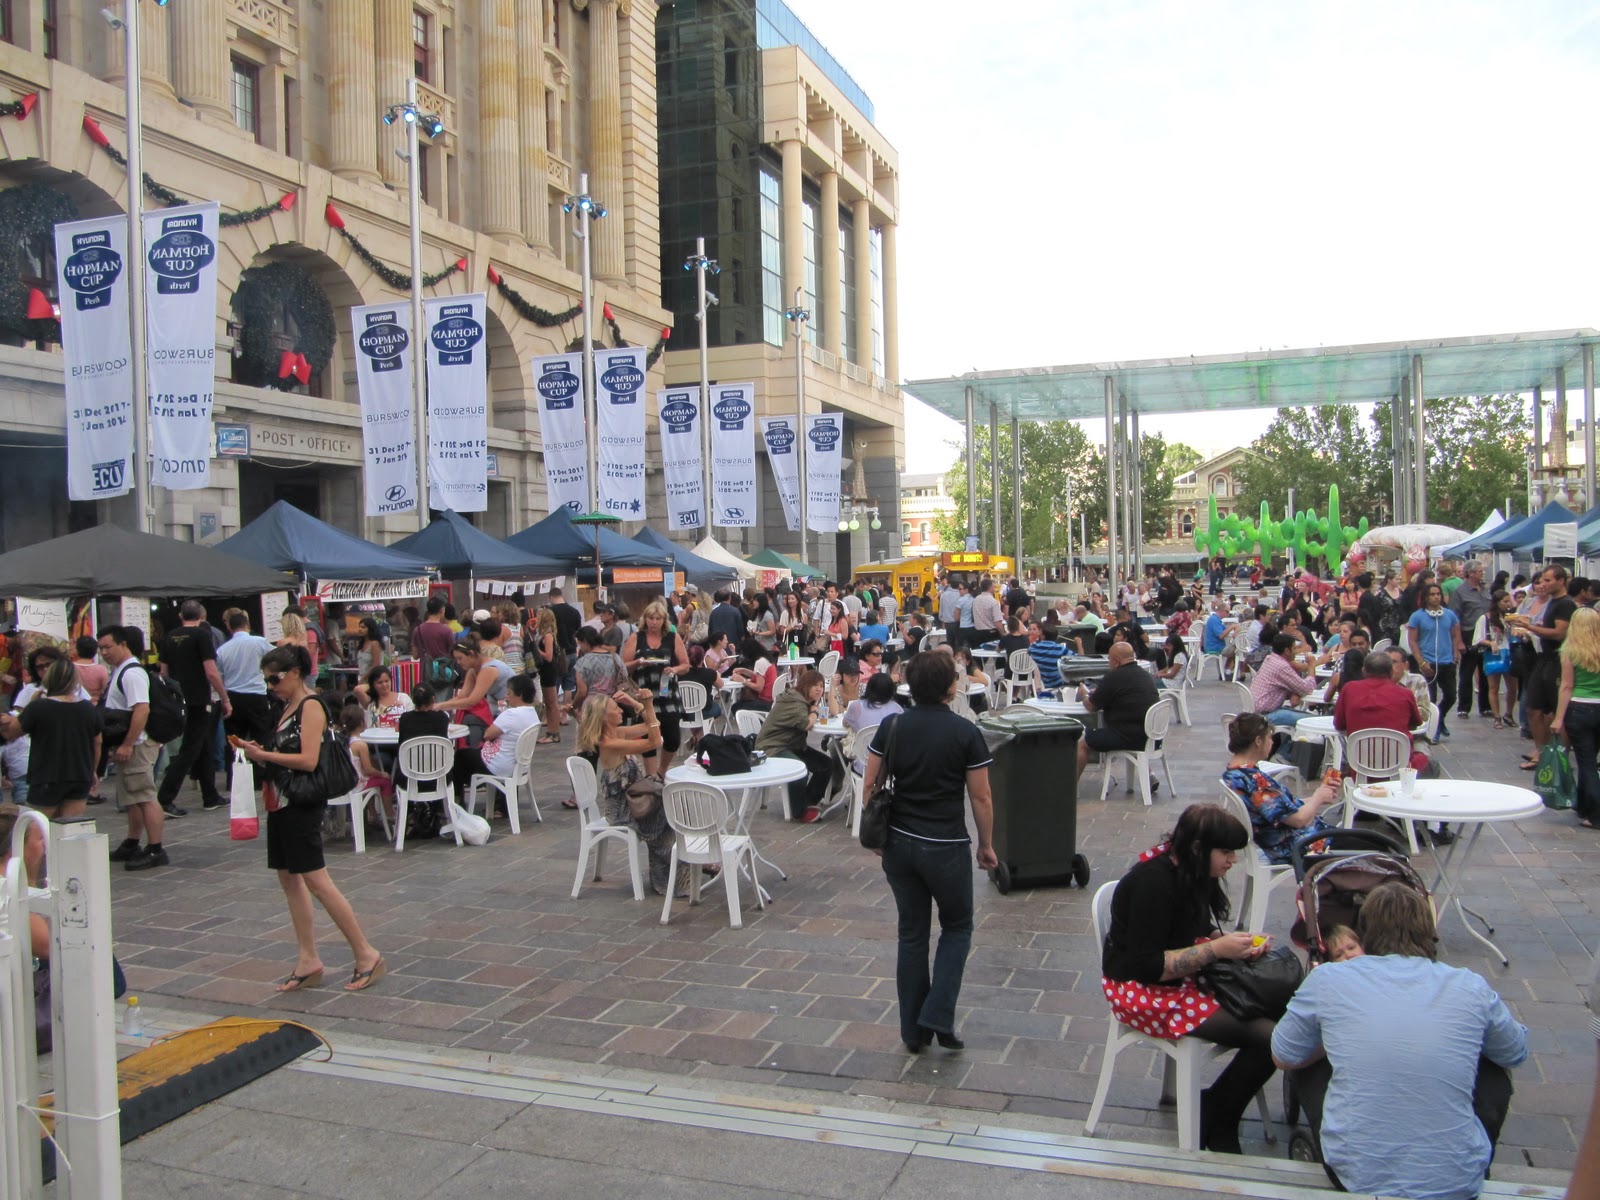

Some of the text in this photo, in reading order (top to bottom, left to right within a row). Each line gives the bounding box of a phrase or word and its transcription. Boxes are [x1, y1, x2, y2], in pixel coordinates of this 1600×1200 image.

[77, 235, 104, 244] HYUNDAI
[67, 260, 120, 276] HOPMAN
[81, 274, 104, 287] CUP
[85, 296, 100, 304] Perth
[362, 334, 406, 346] HOPMAN
[376, 346, 394, 355] CUP
[540, 380, 577, 389] HOPMAN
[664, 408, 695, 416] HOPMAN
[86, 422, 104, 430] Jan
[262, 430, 346, 452] POST OFFICE
[92, 466, 122, 489] ECU
[680, 513, 697, 524] ECU
[332, 580, 421, 600] MEXICAN BURRITO BAR
